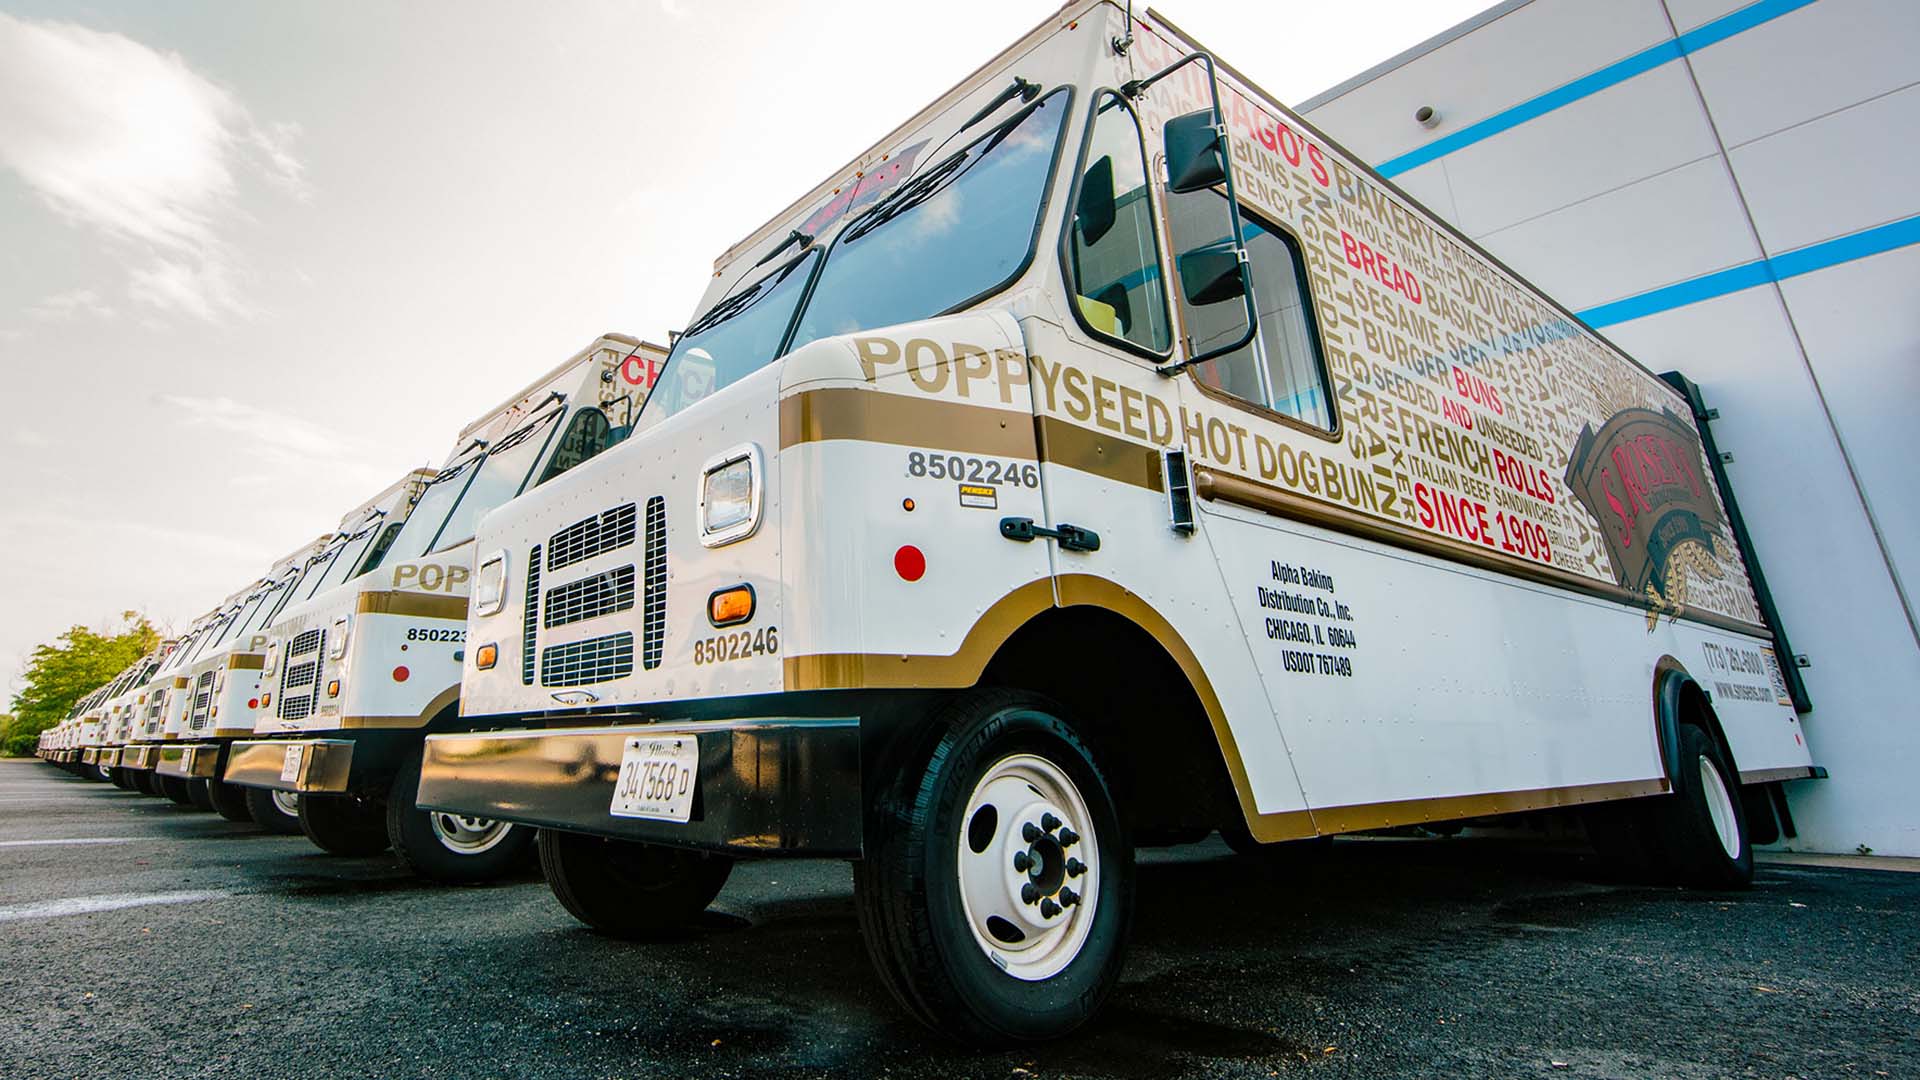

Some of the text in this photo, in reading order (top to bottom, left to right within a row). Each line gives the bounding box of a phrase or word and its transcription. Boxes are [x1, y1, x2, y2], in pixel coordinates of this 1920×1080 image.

[1232, 138, 1290, 190] BUNS
[1332, 160, 1437, 259] BAKERY
[1335, 200, 1448, 289] WHOLE WHEAT
[1292, 174, 1367, 461] INGREDIENTS
[1340, 229, 1422, 304] BREAD
[1422, 280, 1497, 351] BASKET
[1352, 278, 1444, 353] SESAME
[1445, 330, 1493, 380] SEED
[1456, 266, 1534, 344] DOUGH
[1312, 186, 1400, 518] MULTI-GRAIN
[1361, 317, 1503, 415] BURGER BUNS
[1492, 358, 1519, 424] RYE
[1498, 327, 1534, 432] FLOUR
[853, 337, 1379, 513] POPPYSEED HOT DOG BUN
[1372, 362, 1543, 462] SEEDED AND UNSEEDED
[908, 451, 1039, 489] 8502246
[1379, 399, 1417, 523] MIXER
[1397, 406, 1555, 504] FRENCH ROLLS
[1407, 454, 1561, 528] ITALIAN BEEF SANDWICHES
[1414, 482, 1552, 563] SINCE 1909
[1548, 529, 1581, 553] GRILLED
[393, 564, 470, 593] POP
[1271, 560, 1334, 594] Alpha Baking
[1552, 550, 1586, 574] CHEESE
[1257, 586, 1354, 621] Distribution Co., Inc.
[1265, 617, 1357, 649] CHICAGO, IL 60644
[694, 626, 778, 666] 8502246
[1282, 649, 1352, 677] USDOT 767489
[621, 761, 690, 801] 347568 D
